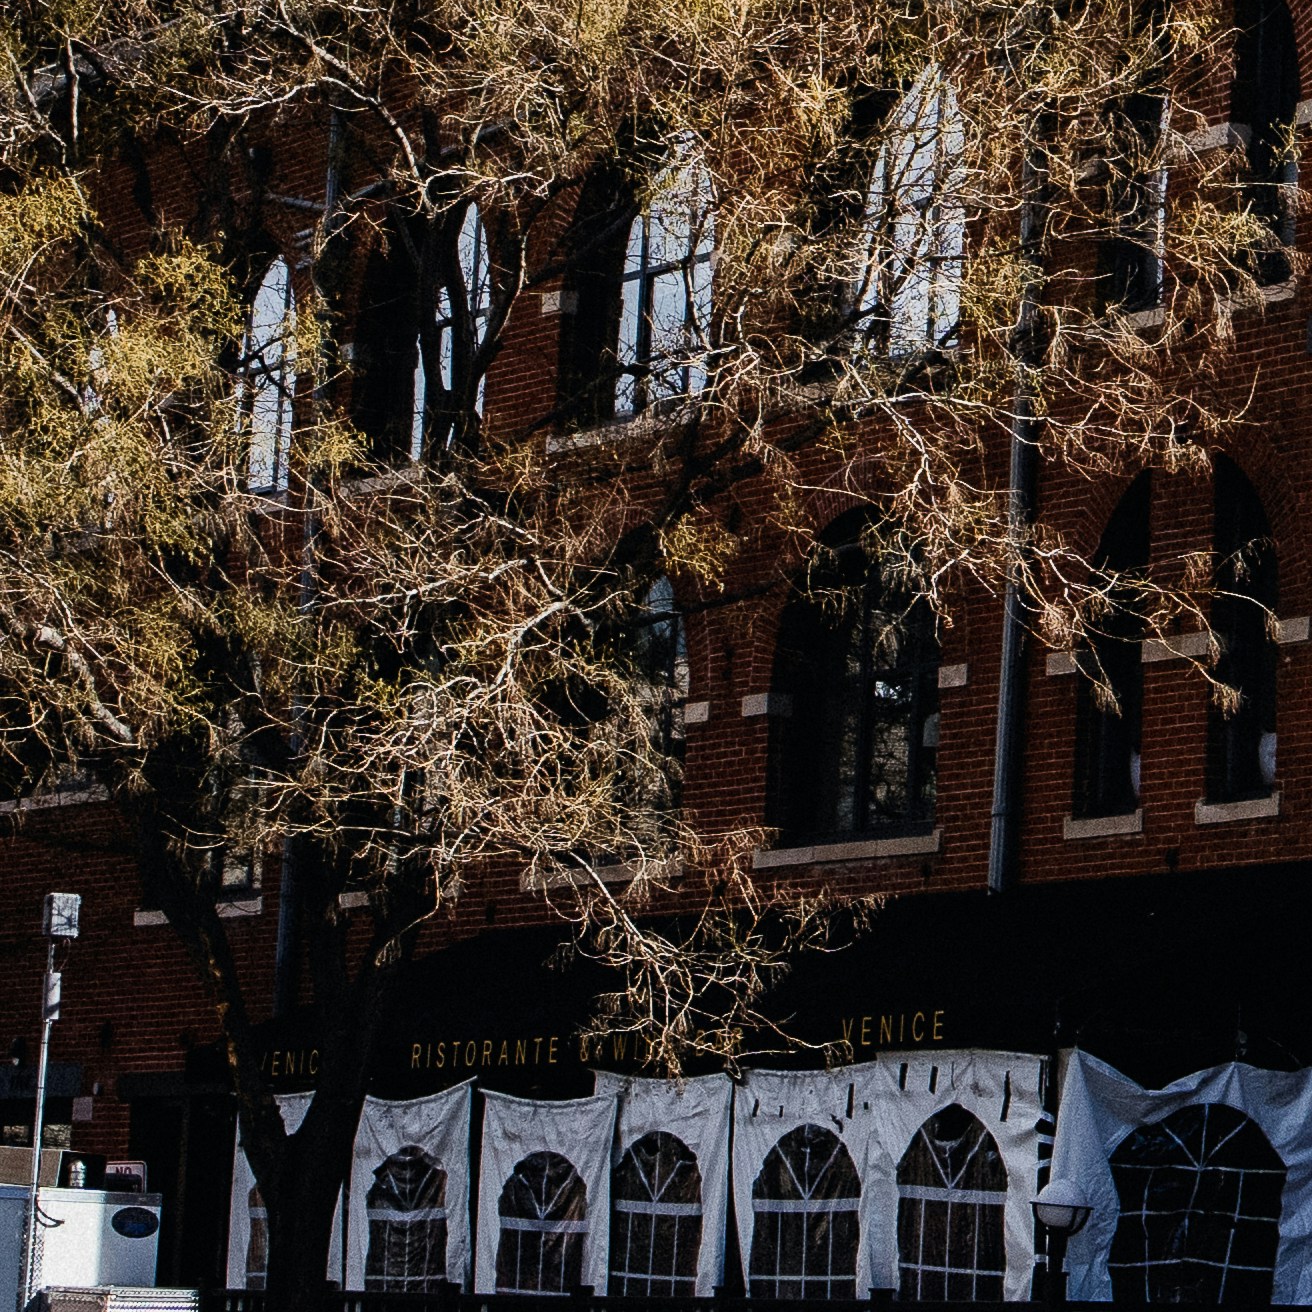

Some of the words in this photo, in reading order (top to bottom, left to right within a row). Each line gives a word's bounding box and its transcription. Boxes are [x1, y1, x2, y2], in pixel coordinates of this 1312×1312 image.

[842, 1010, 945, 1046] VENICE
[260, 1049, 319, 1076] ENIC
[411, 1037, 559, 1070] RISTORANTE
